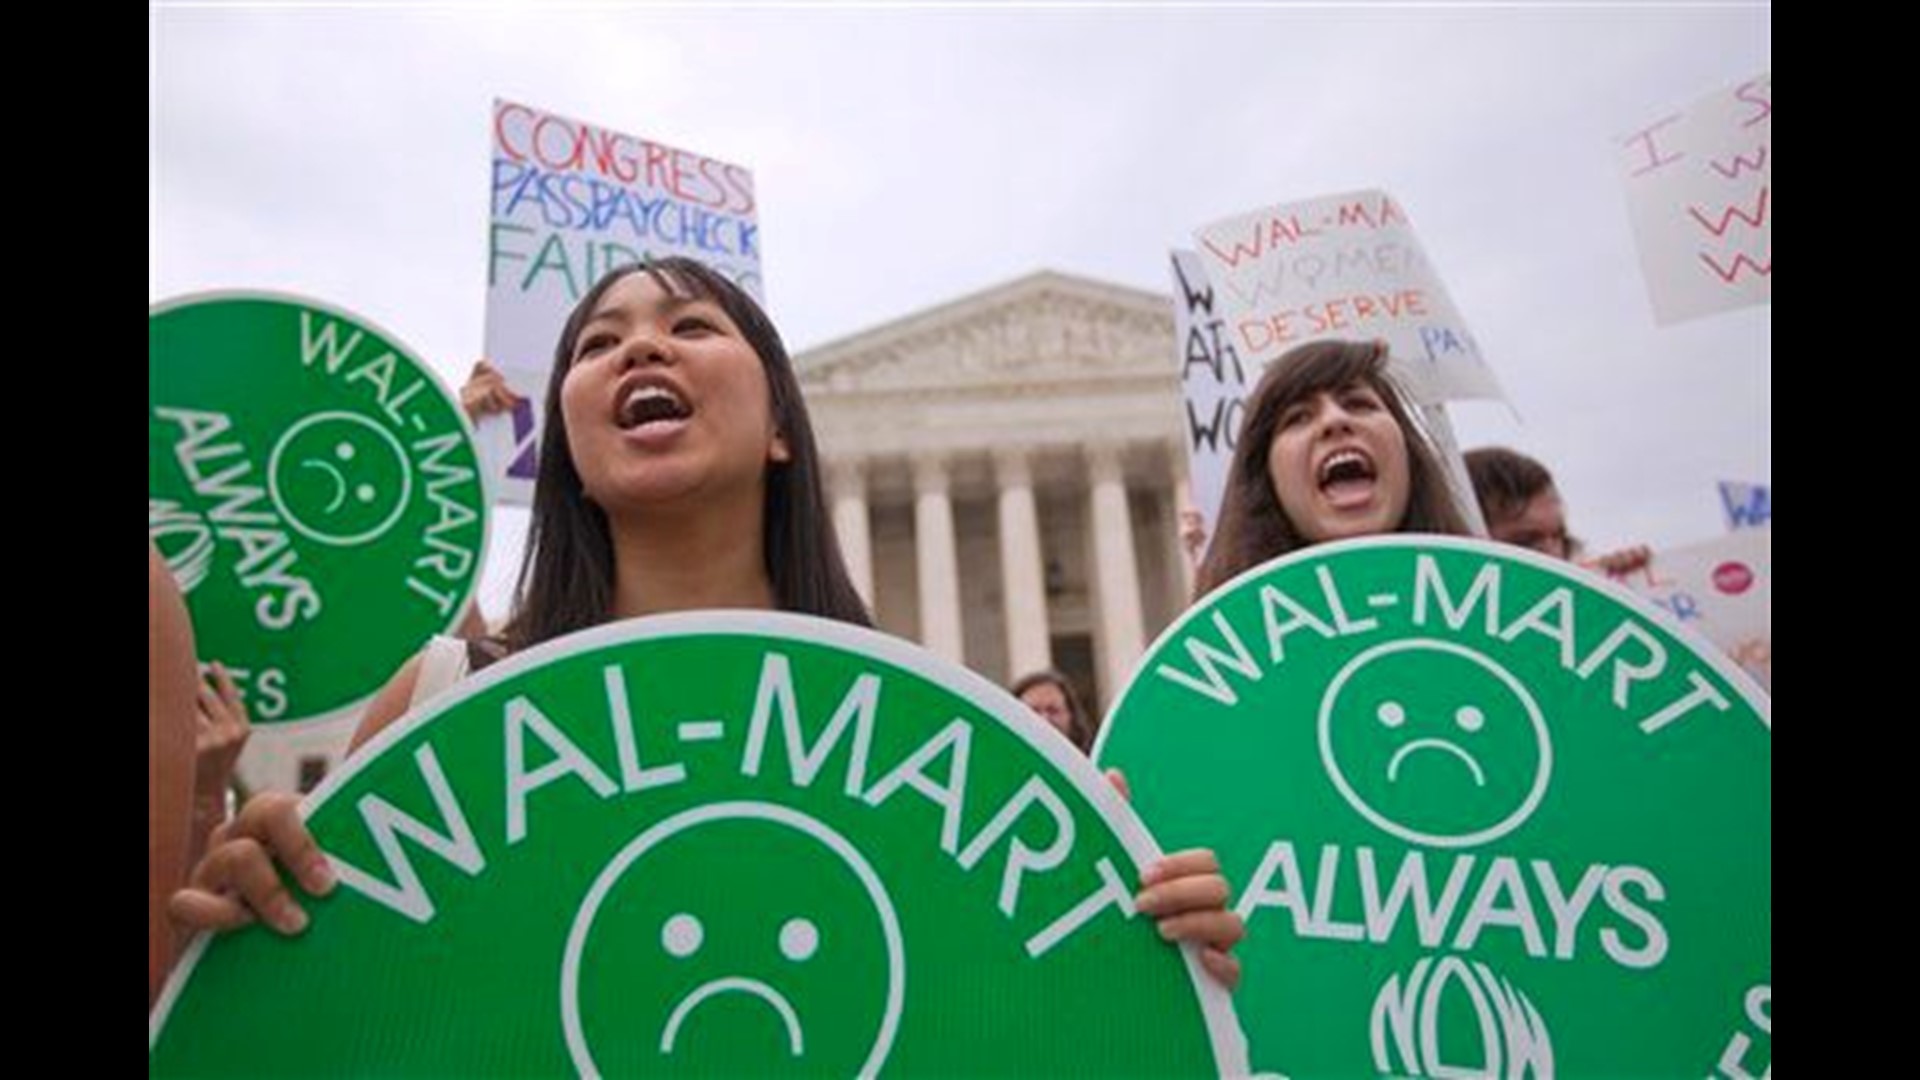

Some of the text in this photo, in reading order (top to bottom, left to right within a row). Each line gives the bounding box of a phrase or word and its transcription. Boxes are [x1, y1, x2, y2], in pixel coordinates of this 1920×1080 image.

[495, 103, 755, 215] CONGRESS
[1239, 289, 1428, 353] DESERVE
[154, 406, 321, 629] ALWAYS
[301, 311, 477, 616] WAL-MART
[1156, 553, 1731, 736] WAL-MART
[333, 653, 1138, 958] WAL-MART
[1238, 841, 1668, 968] ALWAYS
